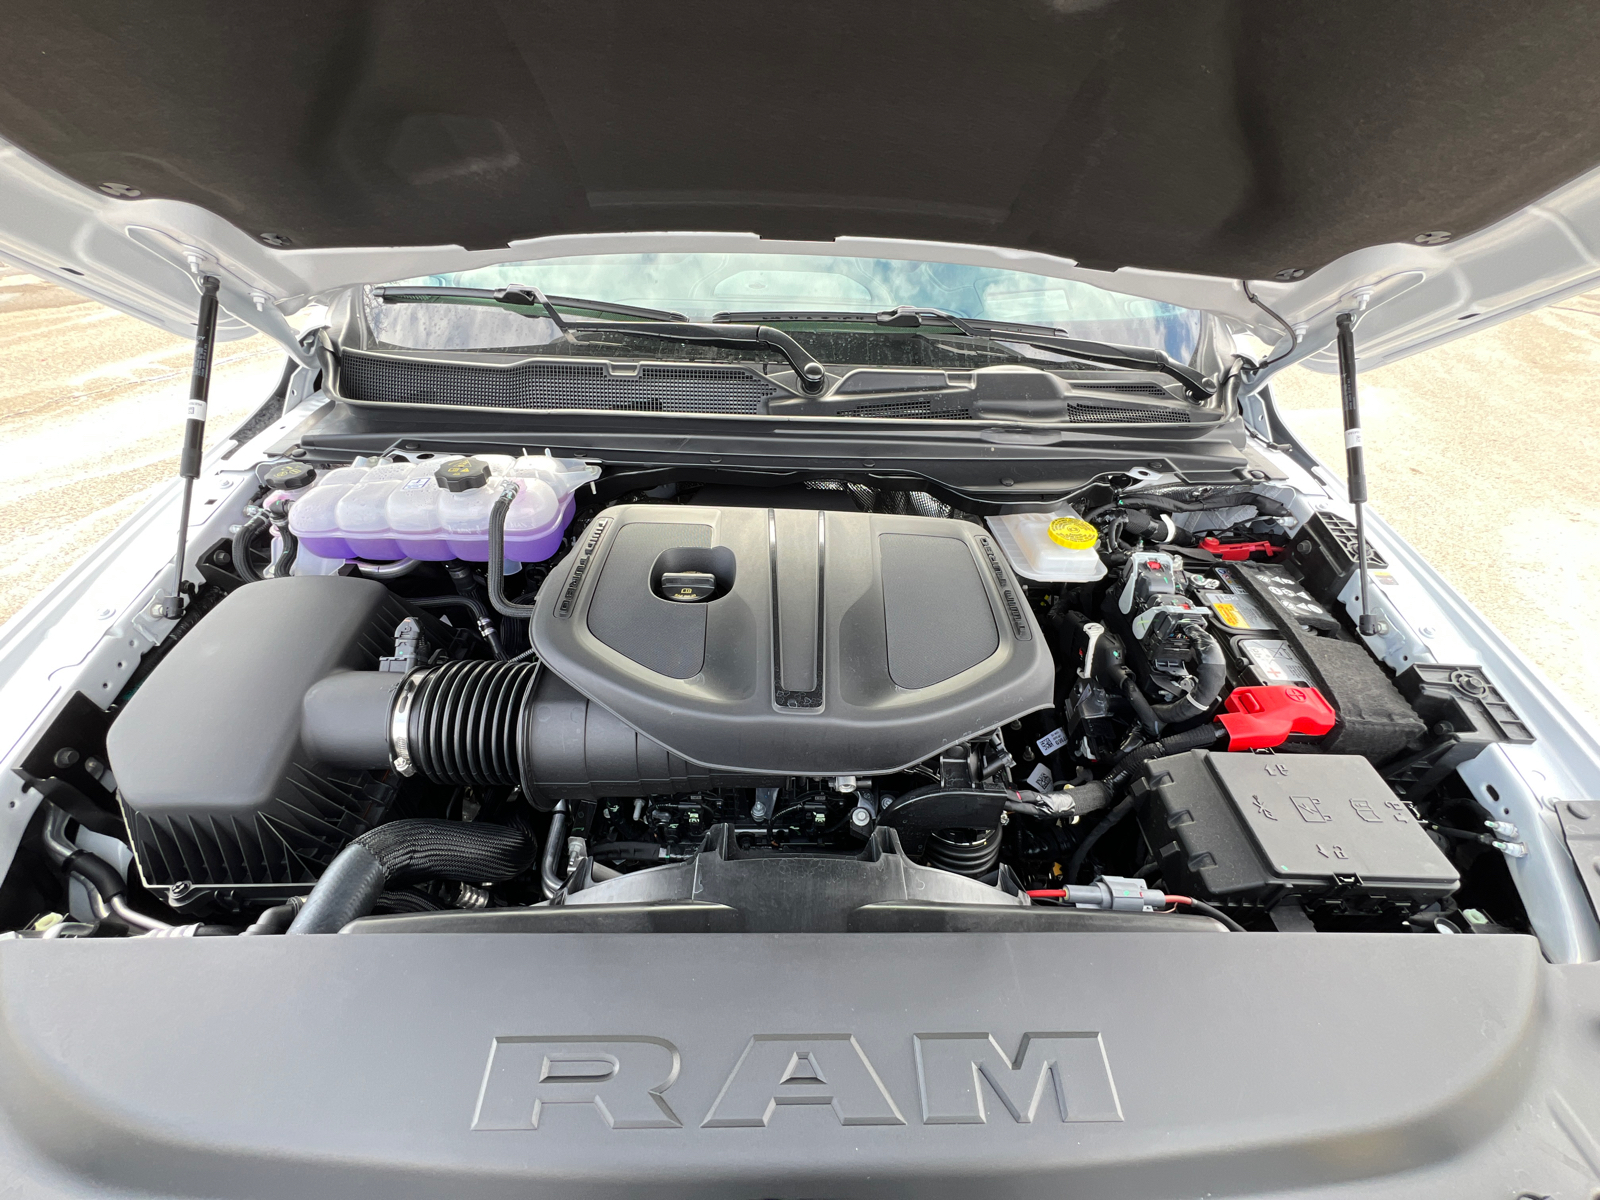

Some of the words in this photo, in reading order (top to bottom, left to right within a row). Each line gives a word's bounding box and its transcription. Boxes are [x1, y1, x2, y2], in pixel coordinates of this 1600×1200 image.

[560, 556, 591, 618] TURBO
[980, 537, 1007, 588] TURBO
[471, 1031, 1126, 1130] RAM
